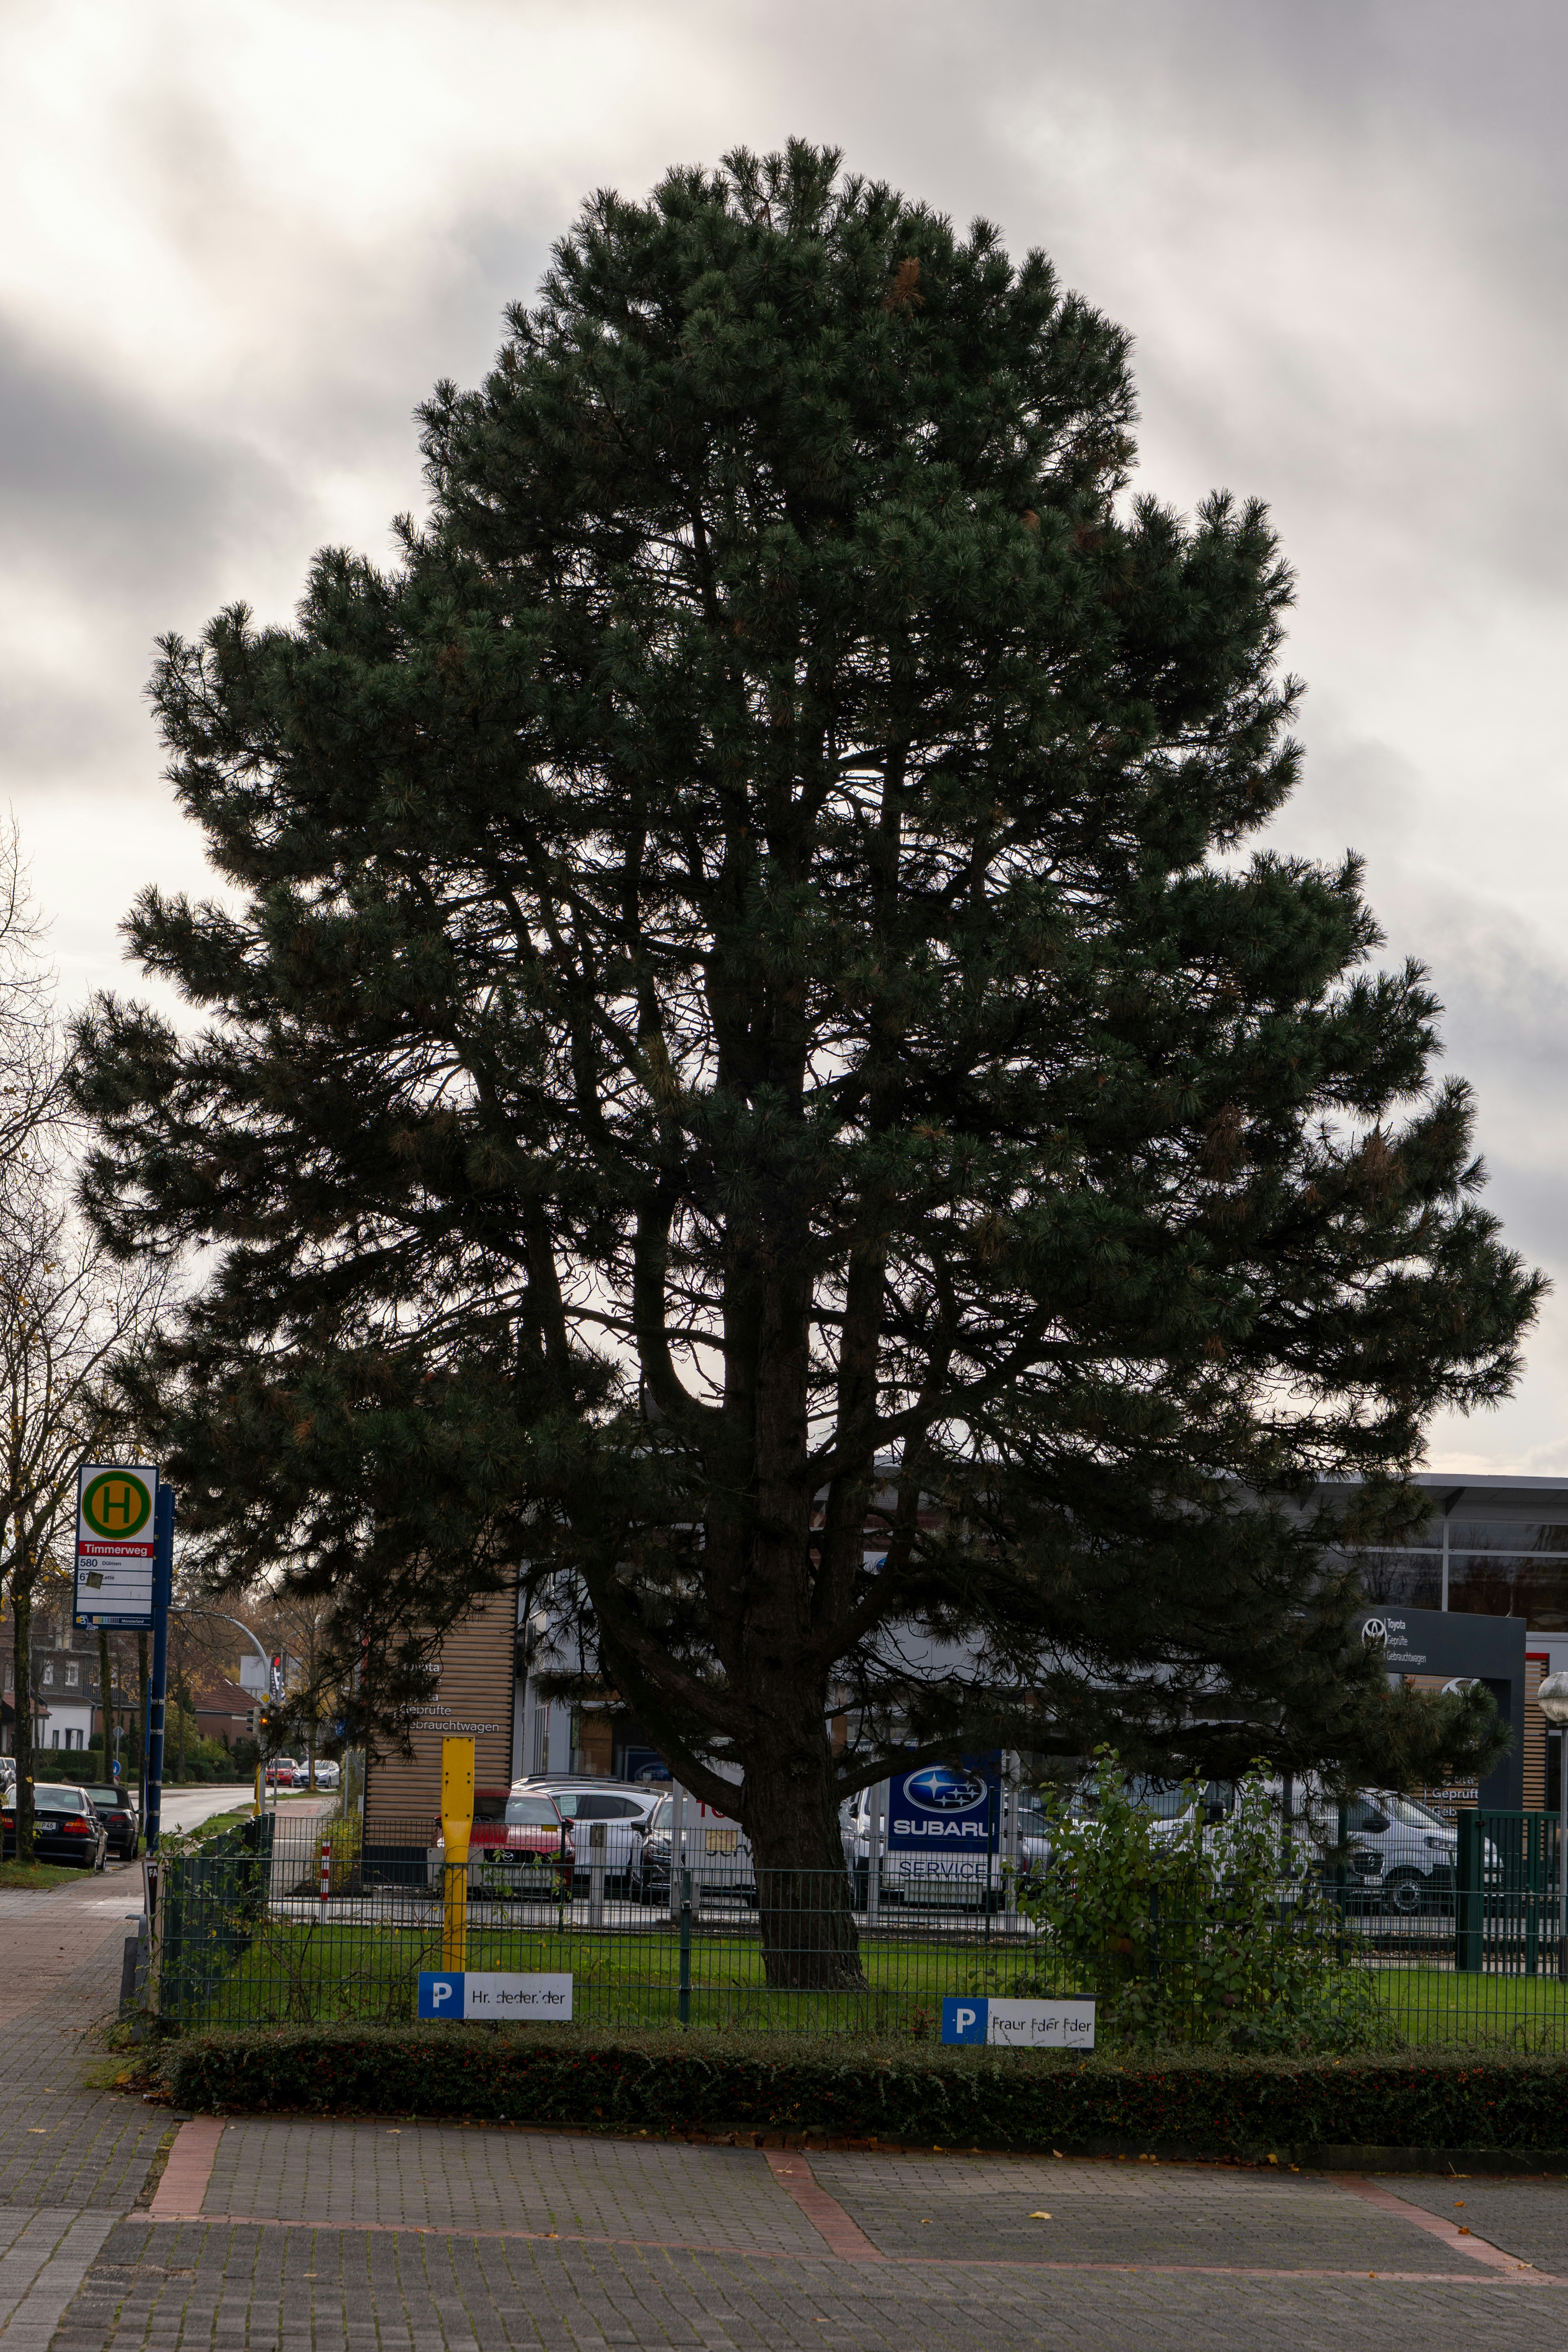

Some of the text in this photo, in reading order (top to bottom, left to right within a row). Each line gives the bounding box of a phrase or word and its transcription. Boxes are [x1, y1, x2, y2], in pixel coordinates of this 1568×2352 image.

[103, 1486, 130, 1524] H
[85, 1544, 147, 1557] Timmerweg
[80, 1559, 98, 1567] 580
[1387, 1618, 1405, 1631] Toyota
[1387, 1635, 1408, 1647] Geprüfte
[1387, 1651, 1426, 1665] Gebrauchtwagen
[400, 1704, 452, 1716] Geprüfte
[1432, 1788, 1479, 1800] Geprüft
[894, 1820, 995, 1837] SUBARU
[900, 1861, 987, 1879] SERVICE
[433, 1982, 452, 2008] P
[472, 1991, 490, 2004] Hr.
[956, 2009, 976, 2034] P
